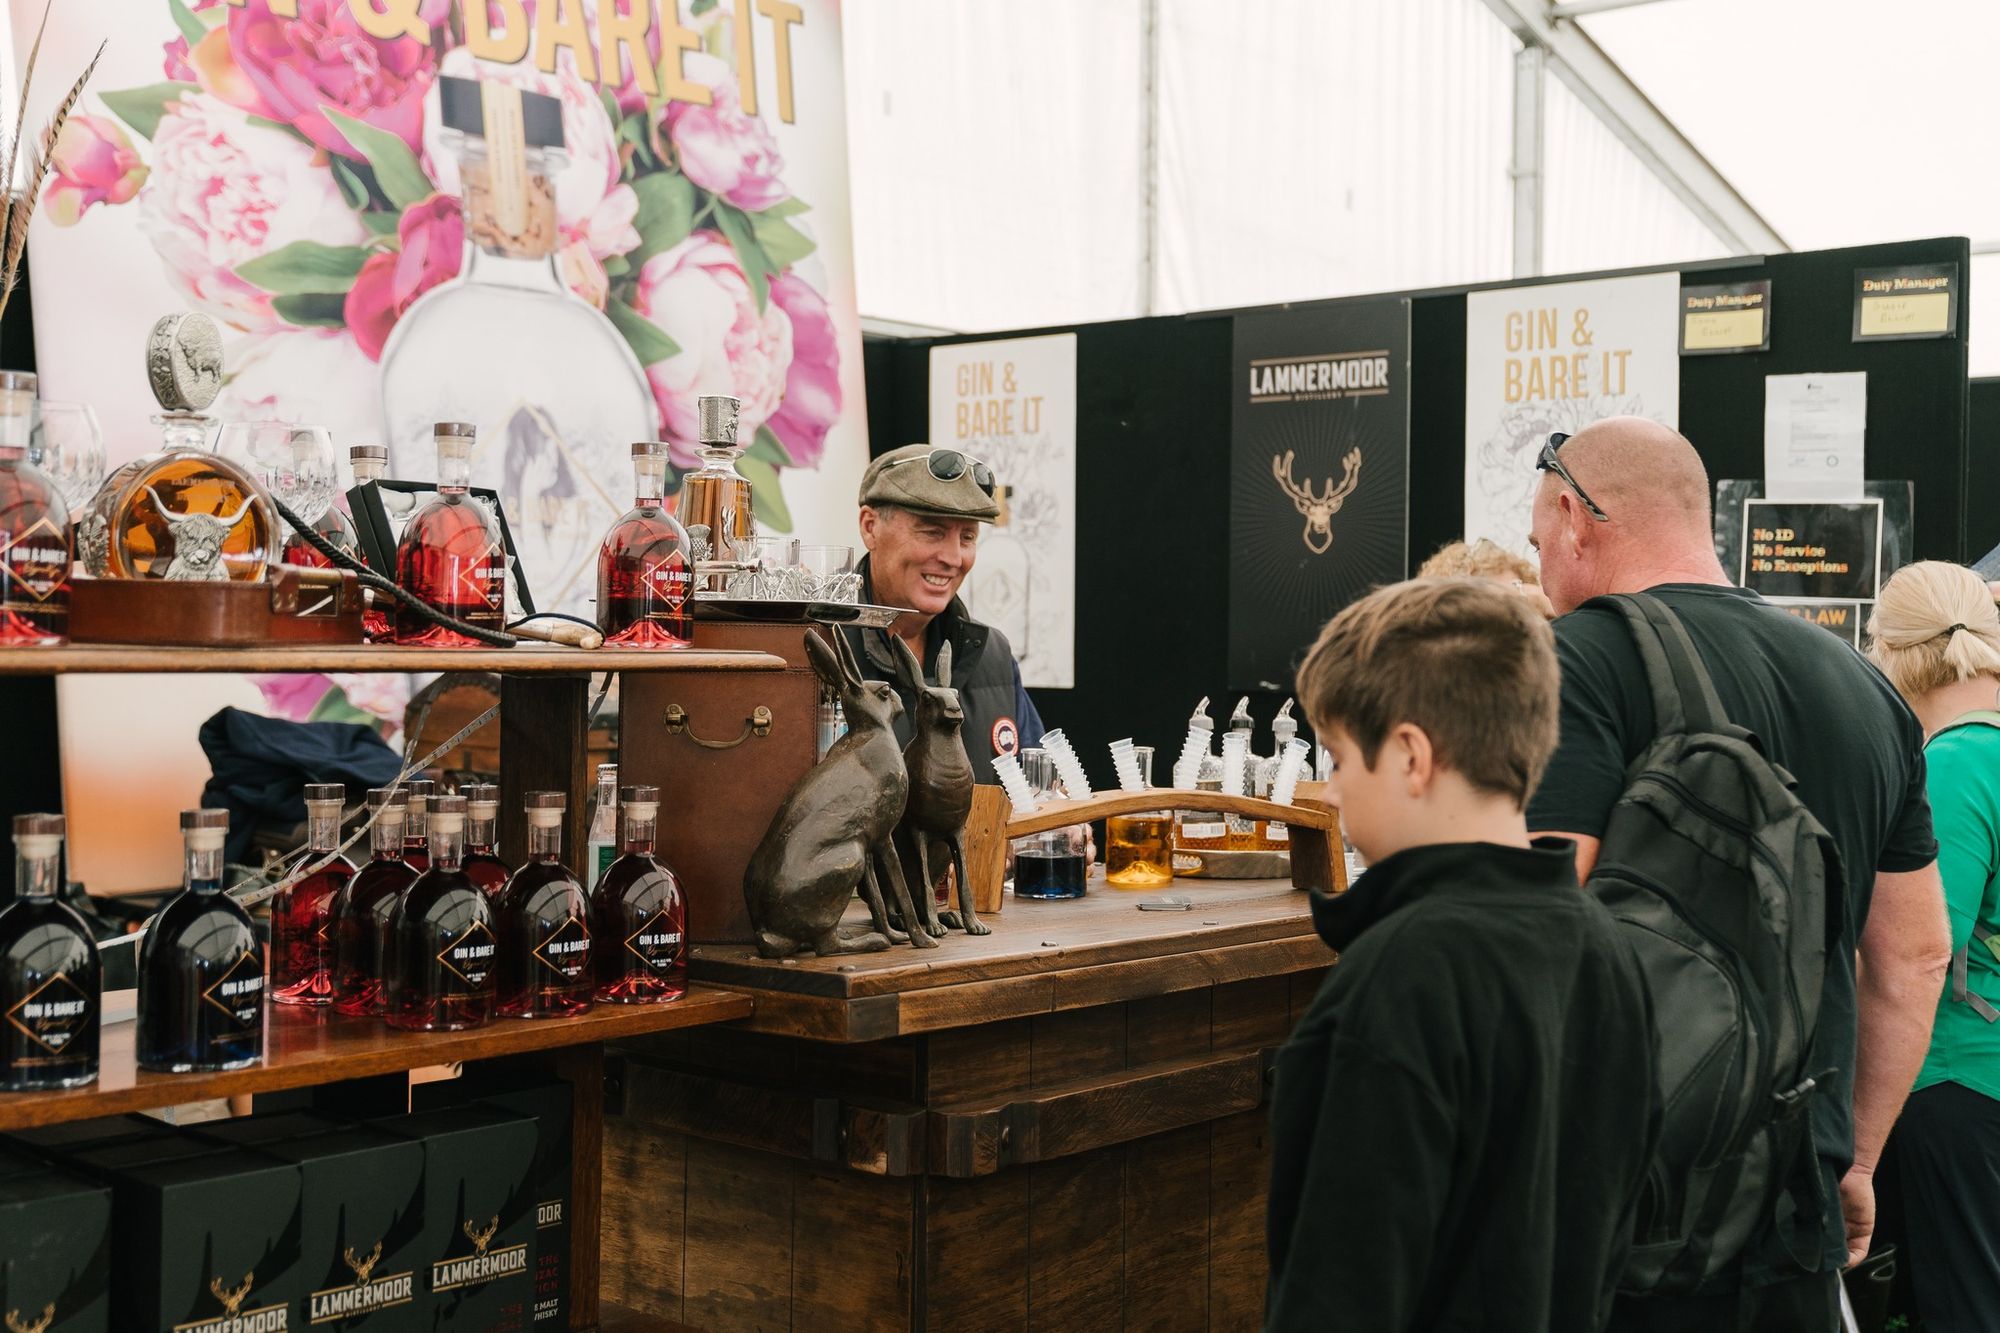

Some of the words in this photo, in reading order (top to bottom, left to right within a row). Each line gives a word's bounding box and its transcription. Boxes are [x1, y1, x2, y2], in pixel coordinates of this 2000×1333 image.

[1863, 279, 1892, 292] Duty
[1893, 277, 1949, 290] Manager
[1687, 296, 1715, 309] Duty
[1715, 293, 1763, 306] Manager
[1504, 307, 1558, 352] GIN
[1571, 308, 1593, 346] &
[956, 360, 994, 397] GIN
[1002, 361, 1018, 393] &
[1249, 357, 1389, 395] LAMMERMOOR
[1504, 352, 1589, 403] BARE
[1602, 349, 1633, 396] IT
[956, 399, 1016, 439] BARE
[1022, 396, 1045, 433] IT
[1752, 528, 1774, 541] No
[1775, 528, 1795, 541] ID
[1752, 544, 1773, 556] No
[1774, 544, 1826, 557] Service
[1752, 559, 1773, 572] No
[1774, 560, 1849, 575] Exceptions
[655, 571, 668, 581] GIN
[1804, 608, 1847, 625] LAW
[640, 934, 652, 946] GIN
[454, 947, 469, 960] GIN
[549, 943, 562, 955] GIN
[432, 1248, 527, 1288] LAMMERMOOR
[311, 1276, 413, 1319] LAMMERMOOR
[175, 1308, 287, 1333] ERMOOR
